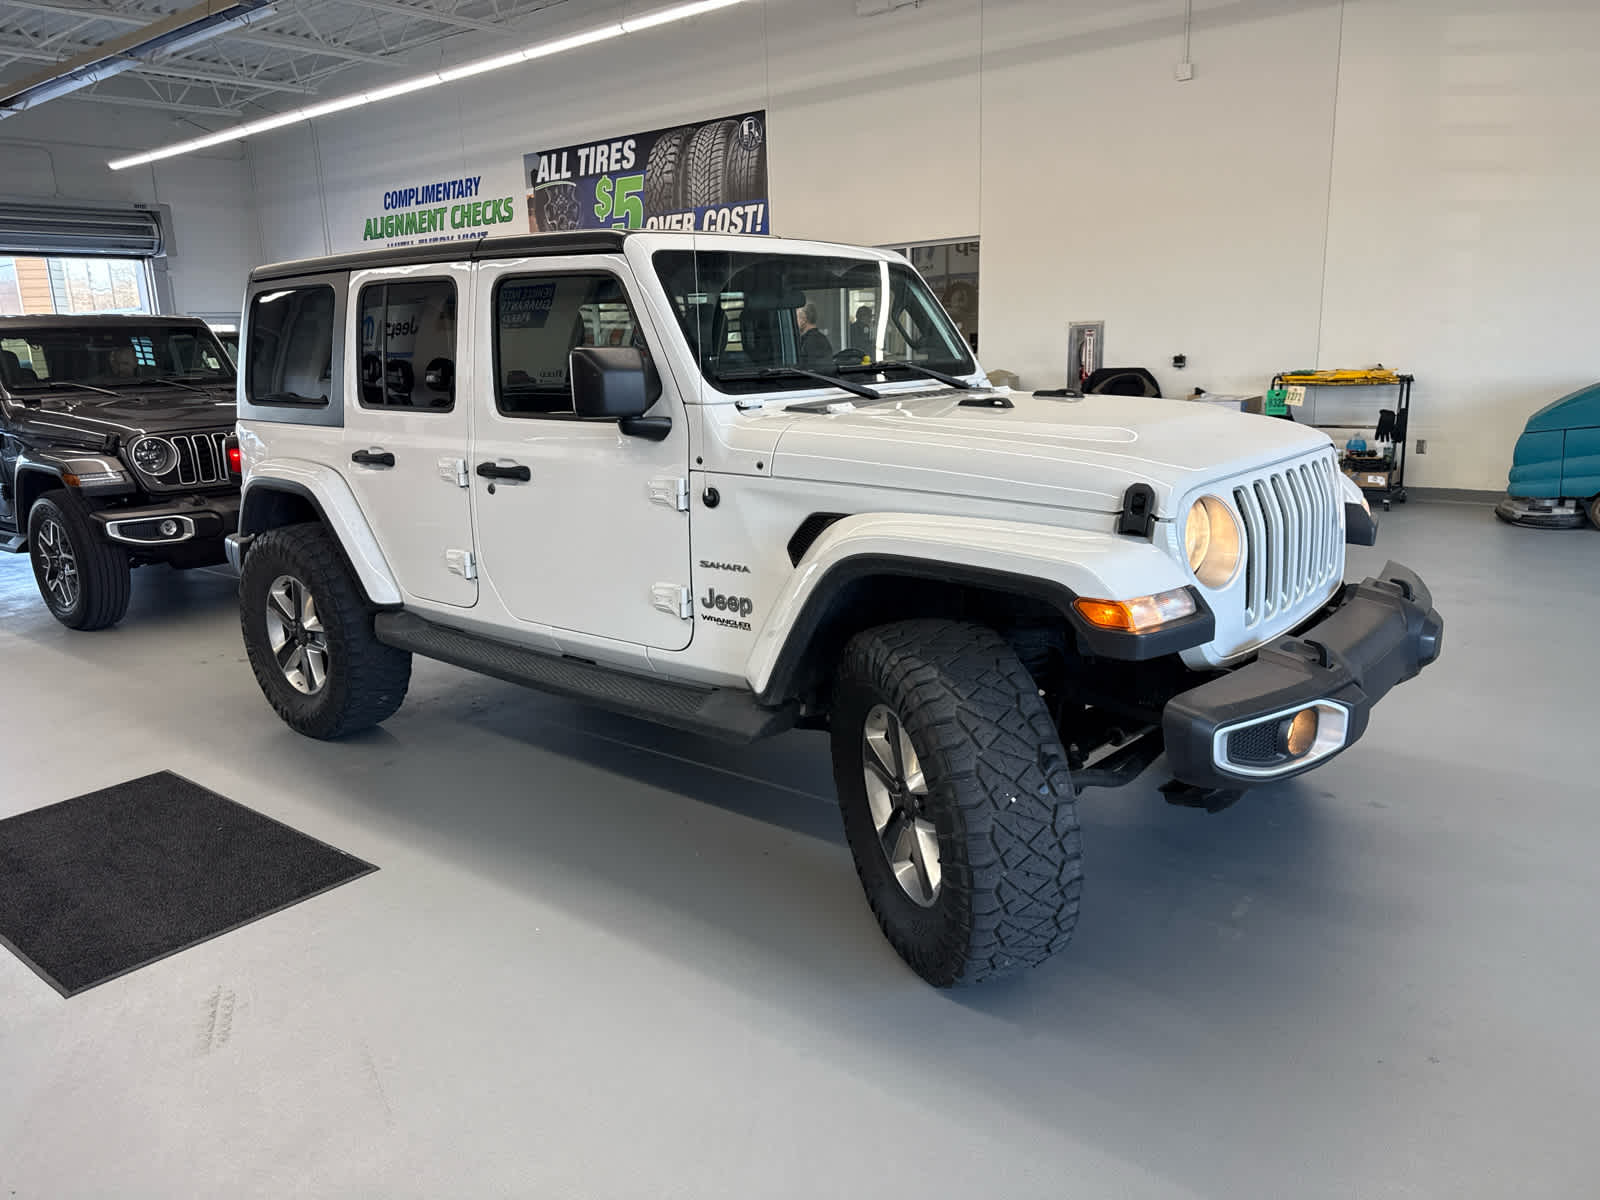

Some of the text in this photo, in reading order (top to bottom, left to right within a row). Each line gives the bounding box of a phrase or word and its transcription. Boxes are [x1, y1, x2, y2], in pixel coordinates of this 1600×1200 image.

[536, 139, 637, 183] ALL TIRES
[384, 176, 482, 210] COMPLIMENTARY
[594, 174, 645, 230] $5
[363, 207, 448, 240] ALIGNMENT
[450, 197, 514, 230] CHECKS
[646, 203, 765, 234] OVER COST!
[699, 560, 752, 574] SAHARA
[700, 587, 753, 618] Jeep
[701, 613, 751, 628] WRANGLER
